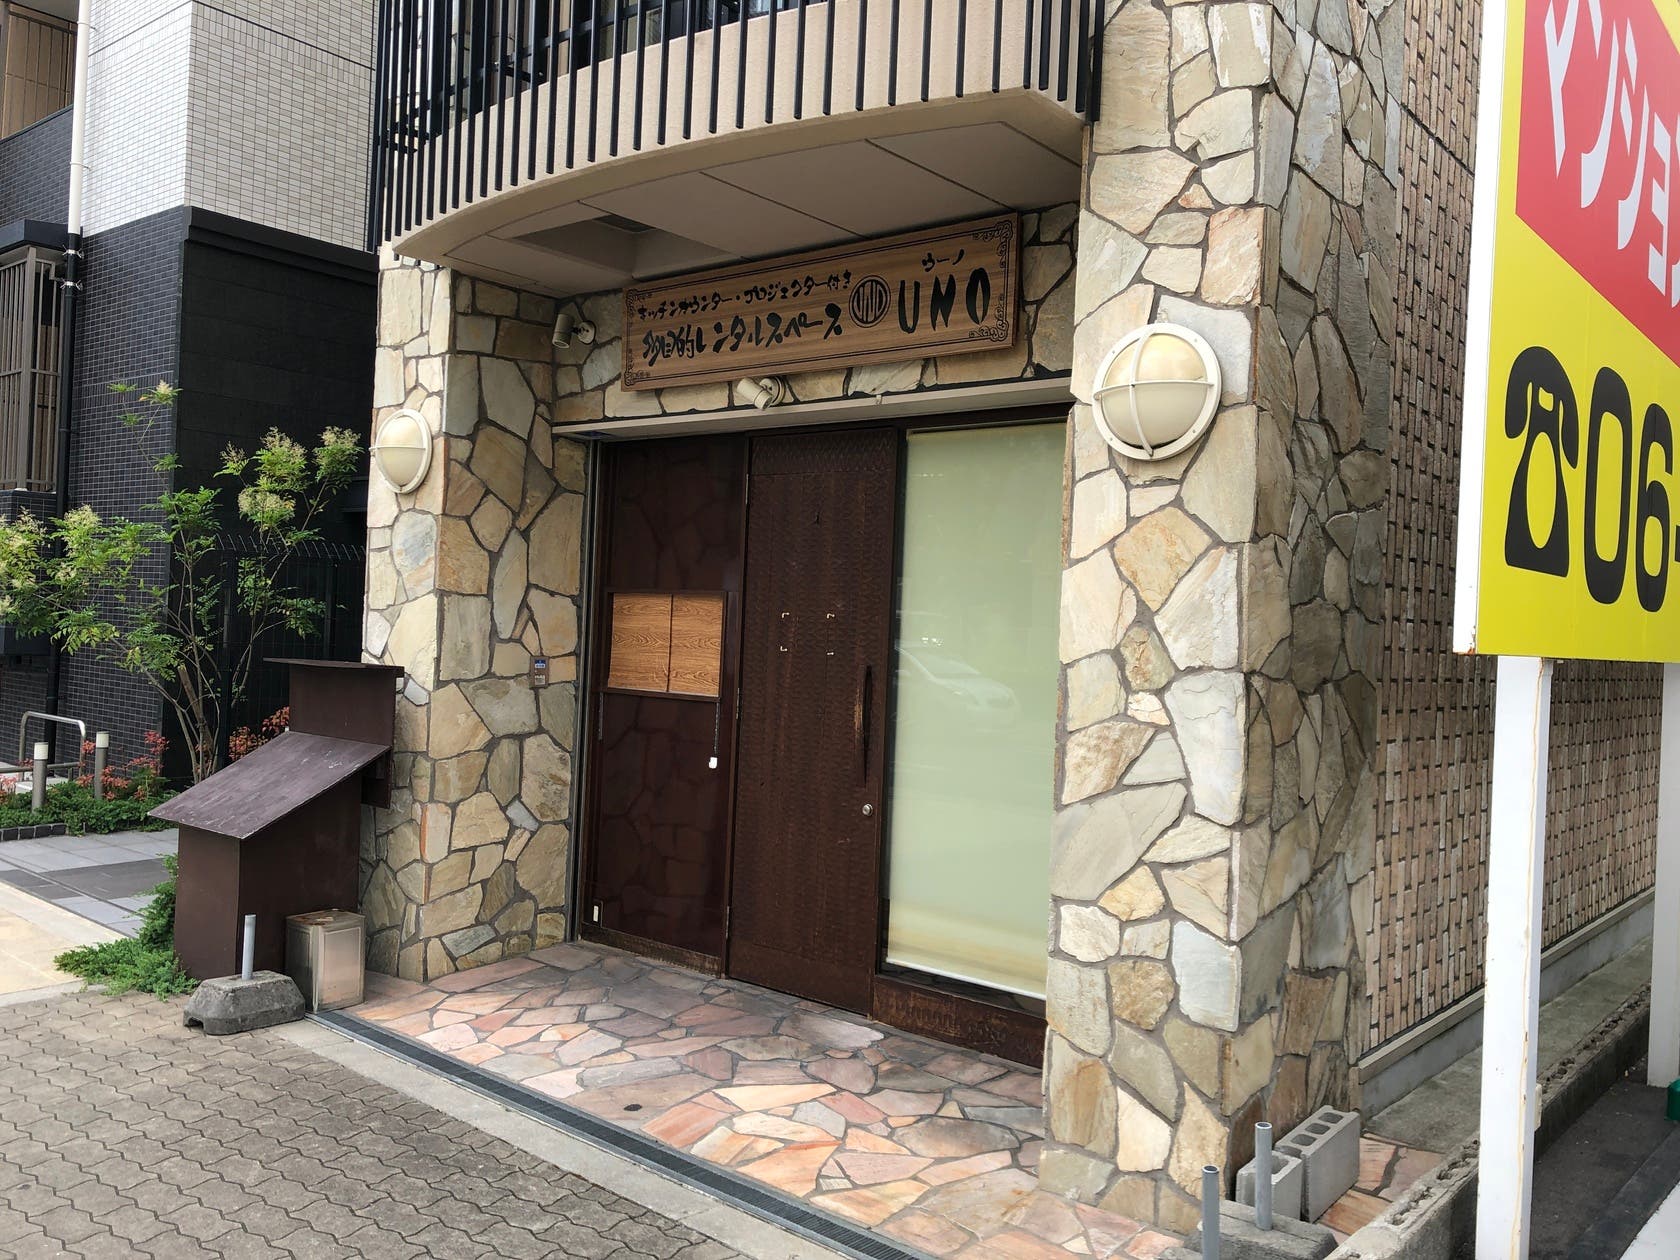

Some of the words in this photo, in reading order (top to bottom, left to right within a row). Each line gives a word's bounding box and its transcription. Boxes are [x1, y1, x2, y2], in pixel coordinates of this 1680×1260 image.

[1544, 0, 1680, 309] マンショ
[921, 249, 965, 272] ウーノ
[898, 267, 991, 334] UNO
[642, 303, 843, 367] 多目的レンタルスペース
[1584, 367, 1680, 612] 06
